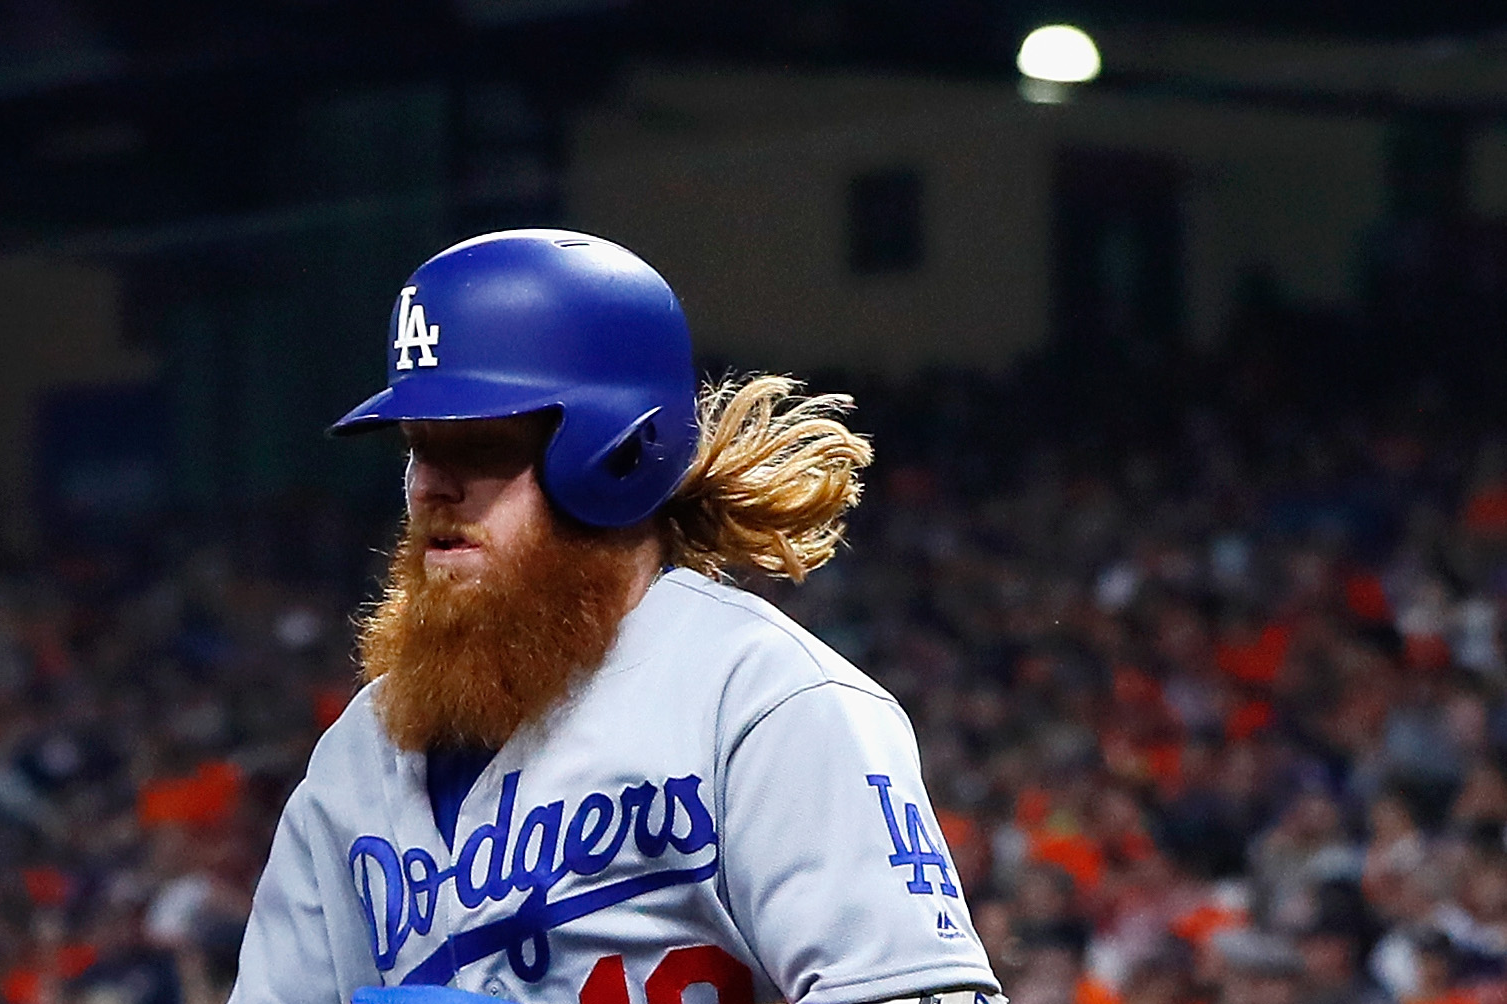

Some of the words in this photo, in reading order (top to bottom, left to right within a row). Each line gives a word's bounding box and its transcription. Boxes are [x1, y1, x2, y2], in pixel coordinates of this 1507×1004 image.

[394, 286, 439, 370] LA
[349, 770, 718, 984] Dodgers
[866, 774, 959, 898] LA
